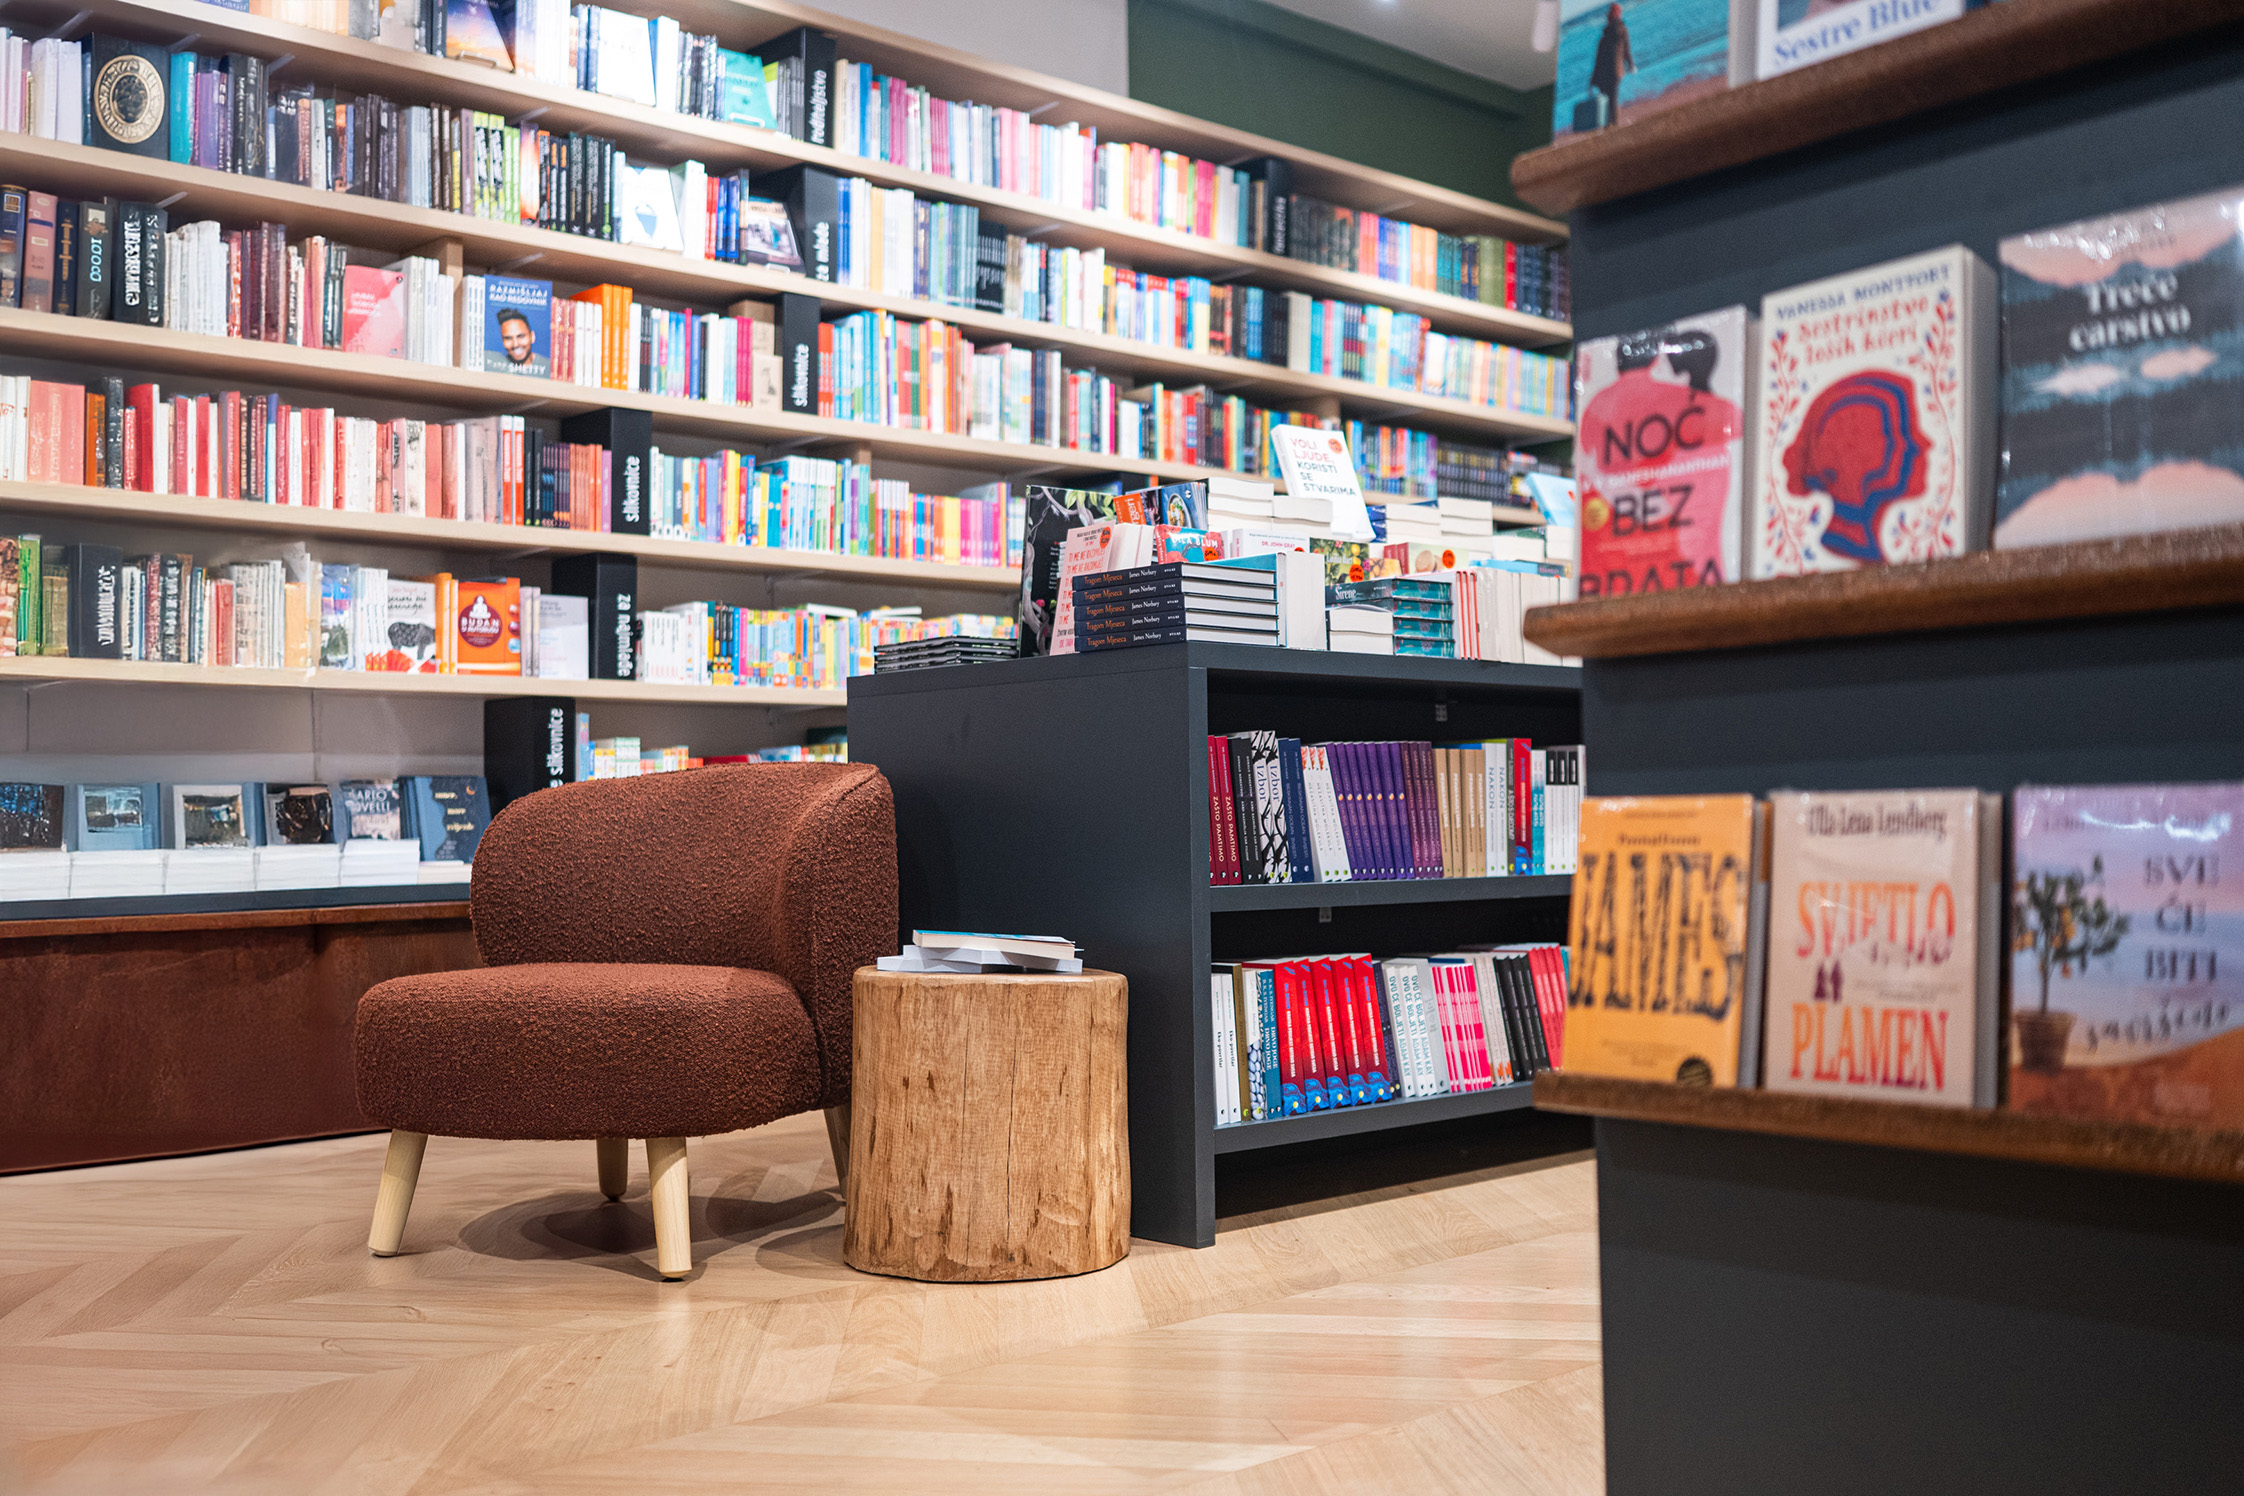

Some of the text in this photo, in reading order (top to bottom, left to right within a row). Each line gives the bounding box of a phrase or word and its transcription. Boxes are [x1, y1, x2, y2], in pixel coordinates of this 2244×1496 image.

[811, 69, 828, 144] roditeljstvo
[1777, 264, 1949, 319] VANESSA MONTFORT
[792, 343, 809, 407] slikovnice
[1289, 438, 1317, 449] VOLI
[1297, 461, 1337, 473] KORISTI
[1300, 472, 1313, 481] SE
[621, 455, 640, 522] slikovnice
[1304, 483, 1357, 496] STVARIMA
[1613, 484, 1694, 536] BEZ
[1084, 569, 1156, 585] Tragom Mjeseca James Norbury
[1084, 585, 1156, 601] Tragom Mjeseca James Norbury
[1335, 586, 1357, 600] Sirene
[1086, 600, 1159, 616] Tragom Mjeseca James Norbury
[1086, 622, 1104, 631] Tragom
[1105, 620, 1125, 630] Mjeseca
[1144, 616, 1160, 624] Norbury
[1087, 632, 1161, 647] Tragom Mjeseca James Norbury
[546, 707, 563, 775] slikovnice
[1257, 765, 1267, 802] Izbor
[1270, 765, 1280, 802] Izbor
[1213, 796, 1225, 862] ZAŠTO PAMTIMO
[1225, 796, 1237, 862] ZAŠTO PAMTIMO
[1389, 975, 1397, 992] OVO
[1402, 975, 1411, 992] OVO
[1411, 975, 1420, 992] OVO
[1393, 1004, 1405, 1037] BOLJETI
[1406, 1003, 1417, 1036] BOLJETI
[1415, 1002, 1427, 1035] BOLJETI
[1399, 1038, 1408, 1061] ADAM
[1412, 1038, 1421, 1060] ADAM
[1421, 1037, 1431, 1059] ADAM
[1790, 1002, 1949, 1092] PLAMEN
[1403, 1062, 1411, 1077] KAY
[1415, 1061, 1423, 1076] KAY
[1425, 1060, 1433, 1075] KAY
